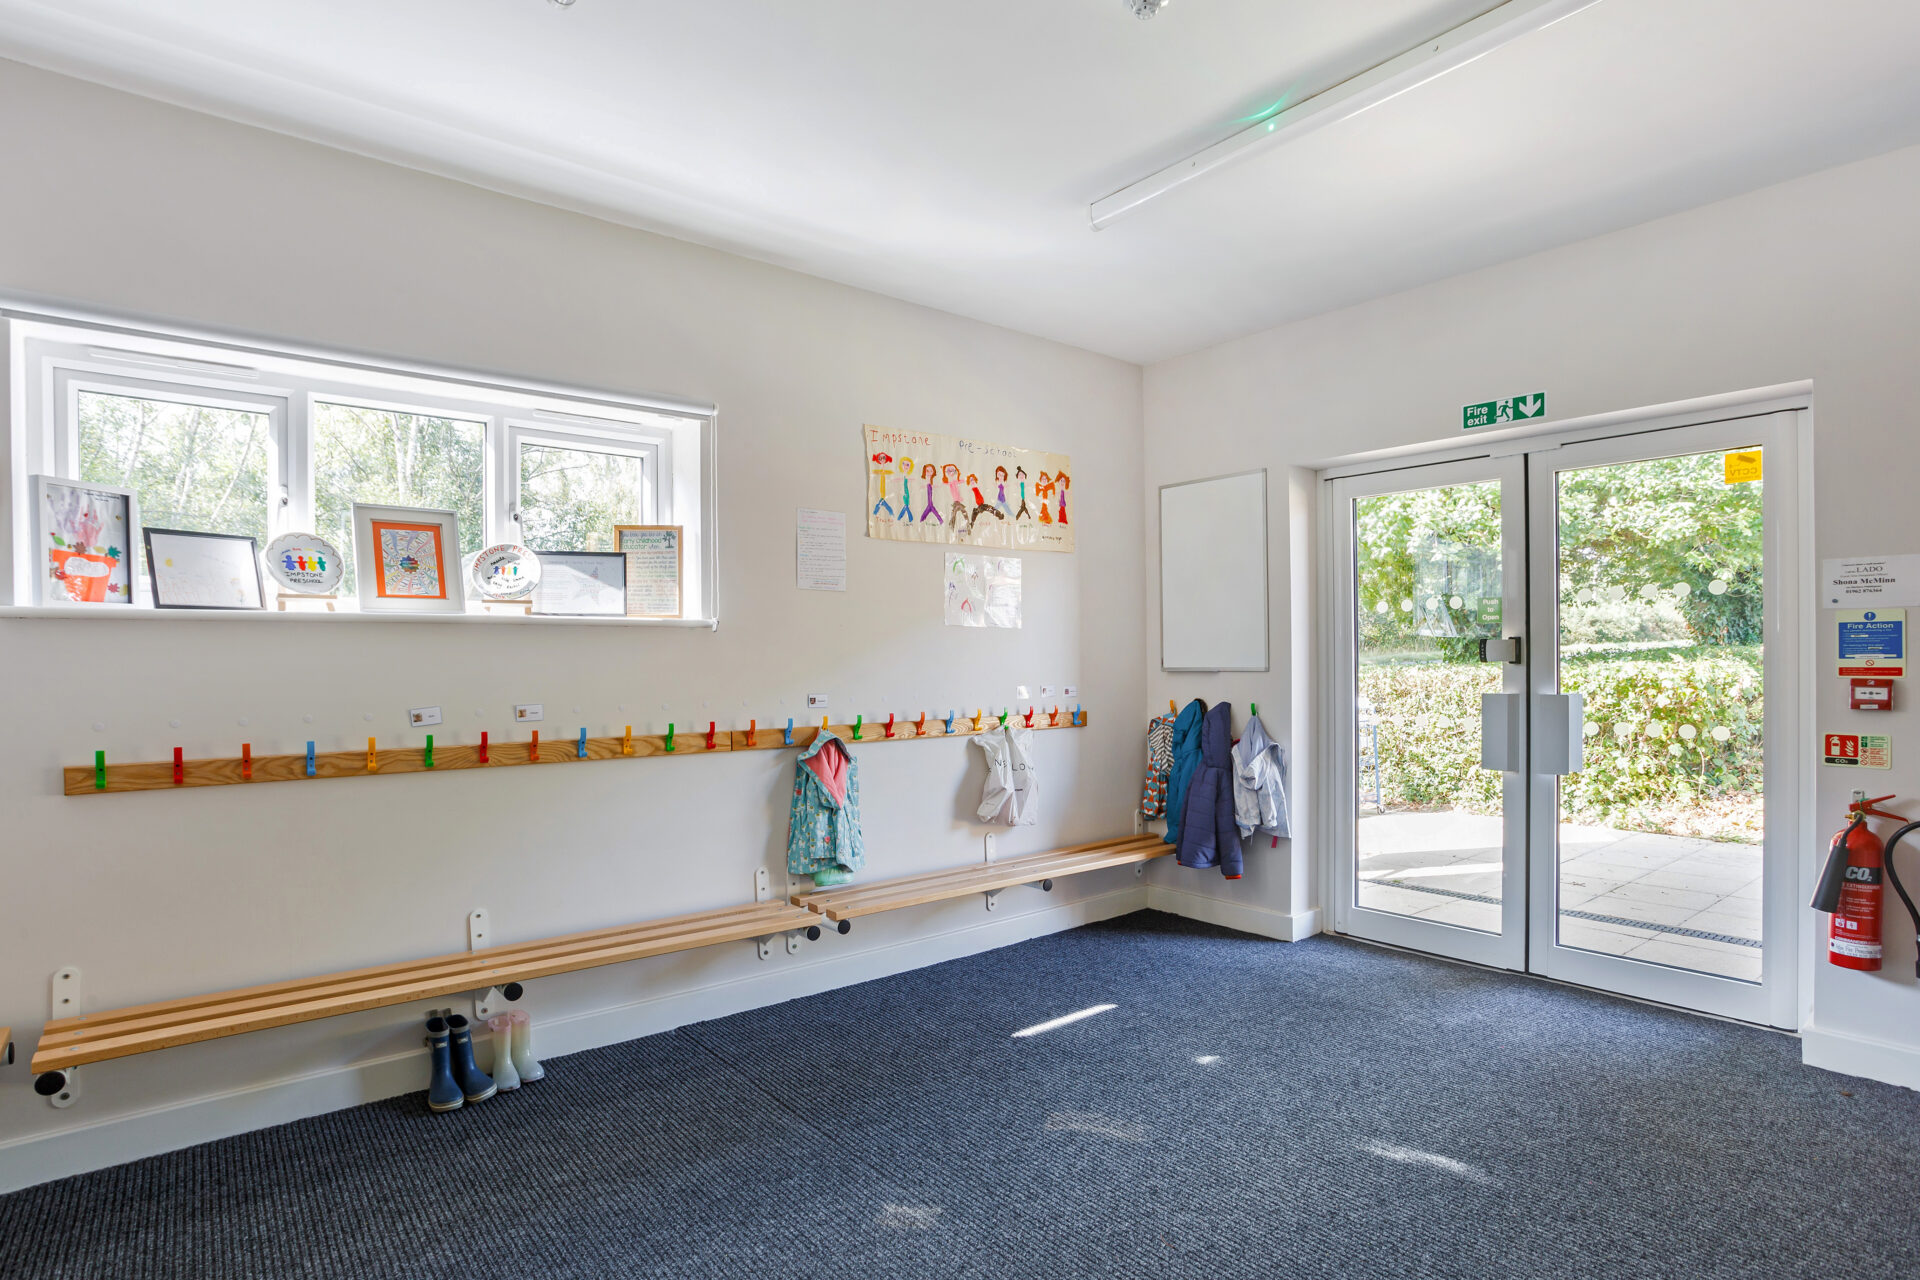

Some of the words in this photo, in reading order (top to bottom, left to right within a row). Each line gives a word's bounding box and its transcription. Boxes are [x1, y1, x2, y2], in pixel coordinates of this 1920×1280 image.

[1467, 406, 1488, 417] Fire
[1467, 415, 1487, 426] exit
[869, 429, 931, 448] Impstone
[473, 545, 505, 573] IMPSTONE
[1860, 577, 1896, 585] McMinn
